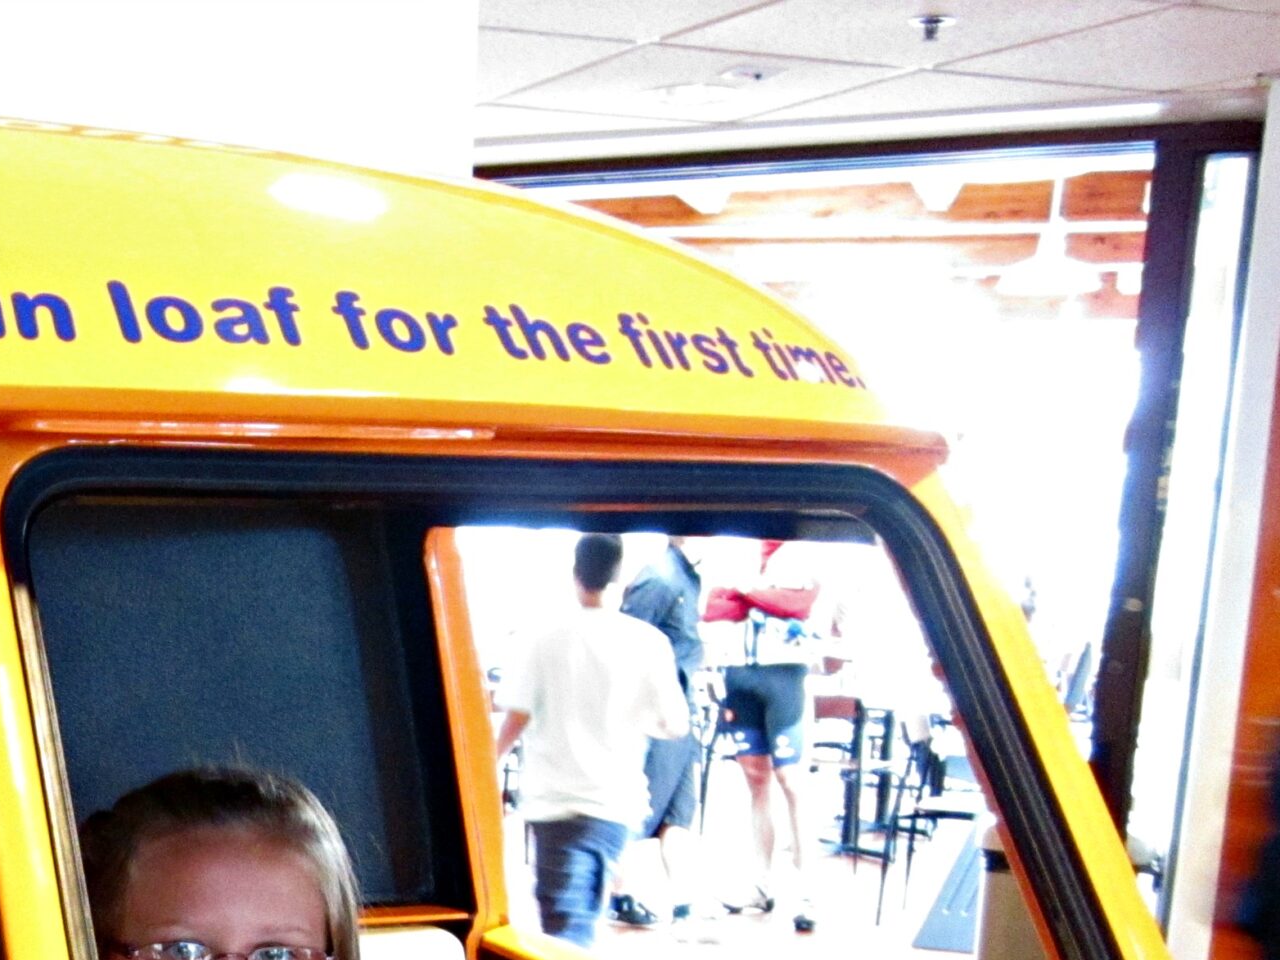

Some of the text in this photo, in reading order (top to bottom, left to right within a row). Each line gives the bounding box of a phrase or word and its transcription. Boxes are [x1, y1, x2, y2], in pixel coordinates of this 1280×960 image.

[107, 280, 303, 347] loaf
[331, 290, 458, 355] for
[482, 303, 612, 364] the
[617, 312, 754, 378] first
[750, 327, 868, 389] time.
